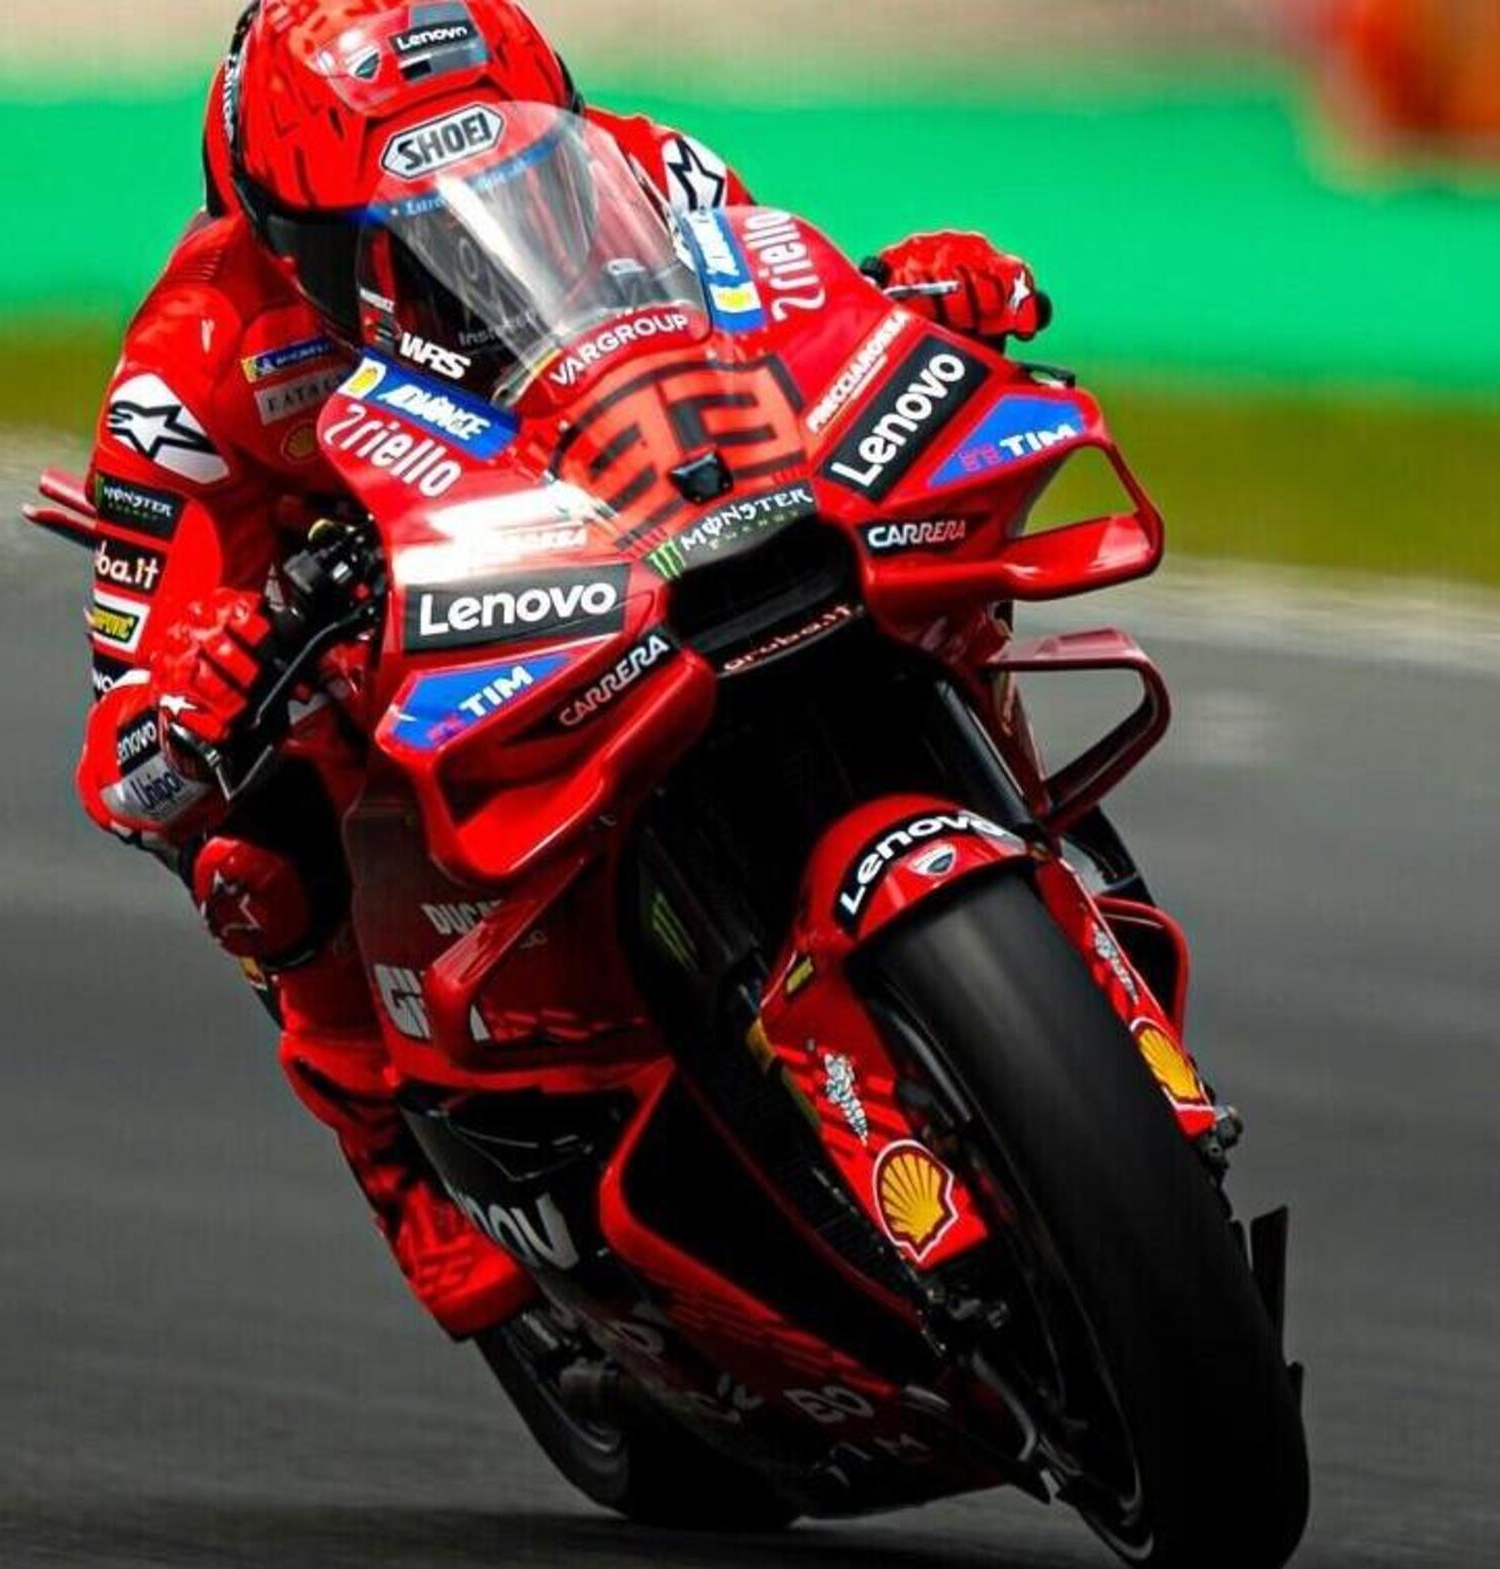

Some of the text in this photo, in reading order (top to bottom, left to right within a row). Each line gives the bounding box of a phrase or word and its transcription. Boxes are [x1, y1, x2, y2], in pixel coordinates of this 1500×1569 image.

[397, 111, 492, 170] SHOEI
[399, 332, 471, 380] WRS
[550, 313, 688, 385] VARGROUP
[831, 353, 966, 487] Lenovo
[1000, 424, 1078, 457] TIM
[680, 488, 813, 550] MONSTER
[867, 520, 966, 548] CARRERA
[420, 583, 618, 636] Lenovo
[459, 665, 534, 717] TIM
[559, 635, 669, 727] CARRERA
[840, 815, 1005, 915] Lenovo
